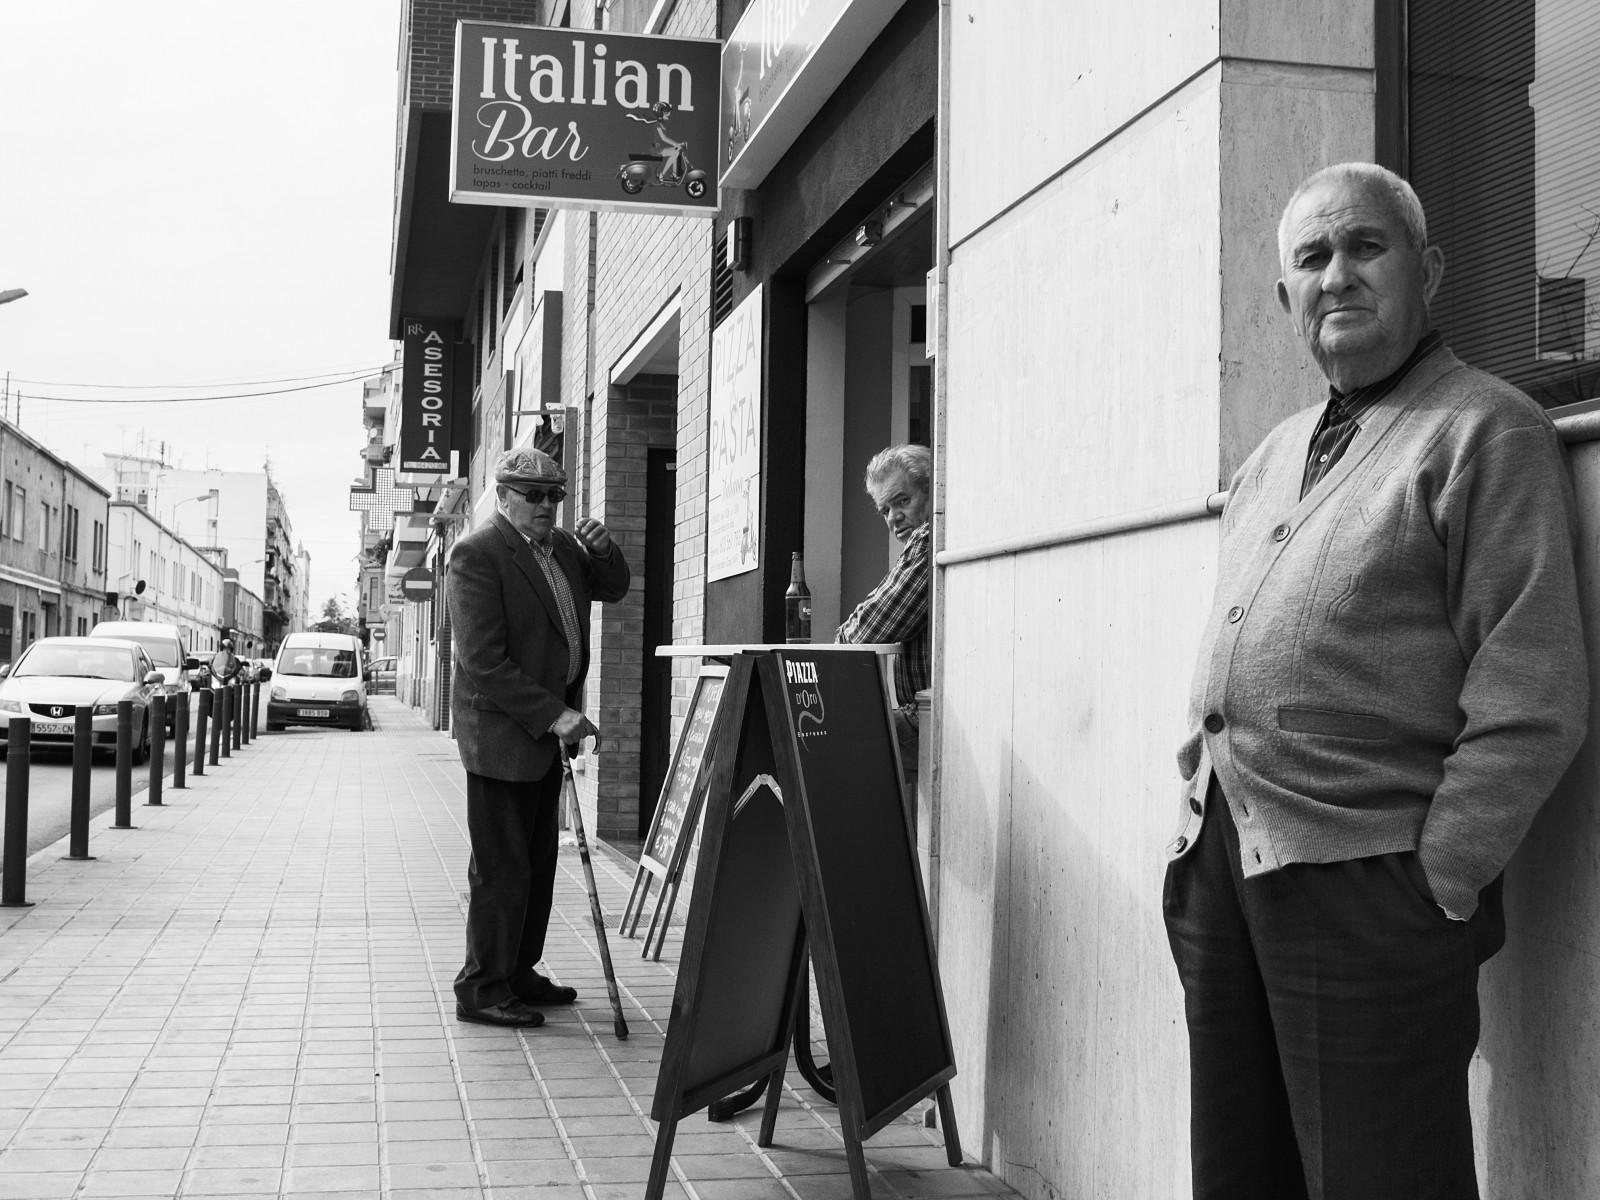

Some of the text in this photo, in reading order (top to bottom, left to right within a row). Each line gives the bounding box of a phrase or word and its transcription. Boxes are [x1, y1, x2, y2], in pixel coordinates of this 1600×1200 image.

[480, 37, 694, 111] Italian
[471, 100, 589, 162] Bar
[473, 163, 592, 181] bruschette, piatti freddi
[473, 178, 501, 189] tapas
[512, 179, 551, 191] cocktail
[714, 305, 756, 394] PIZZA
[420, 330, 444, 460] ASESORIA
[711, 391, 757, 475] PASTA
[785, 659, 819, 684] PIAZZA
[36, 723, 58, 733] 5557
